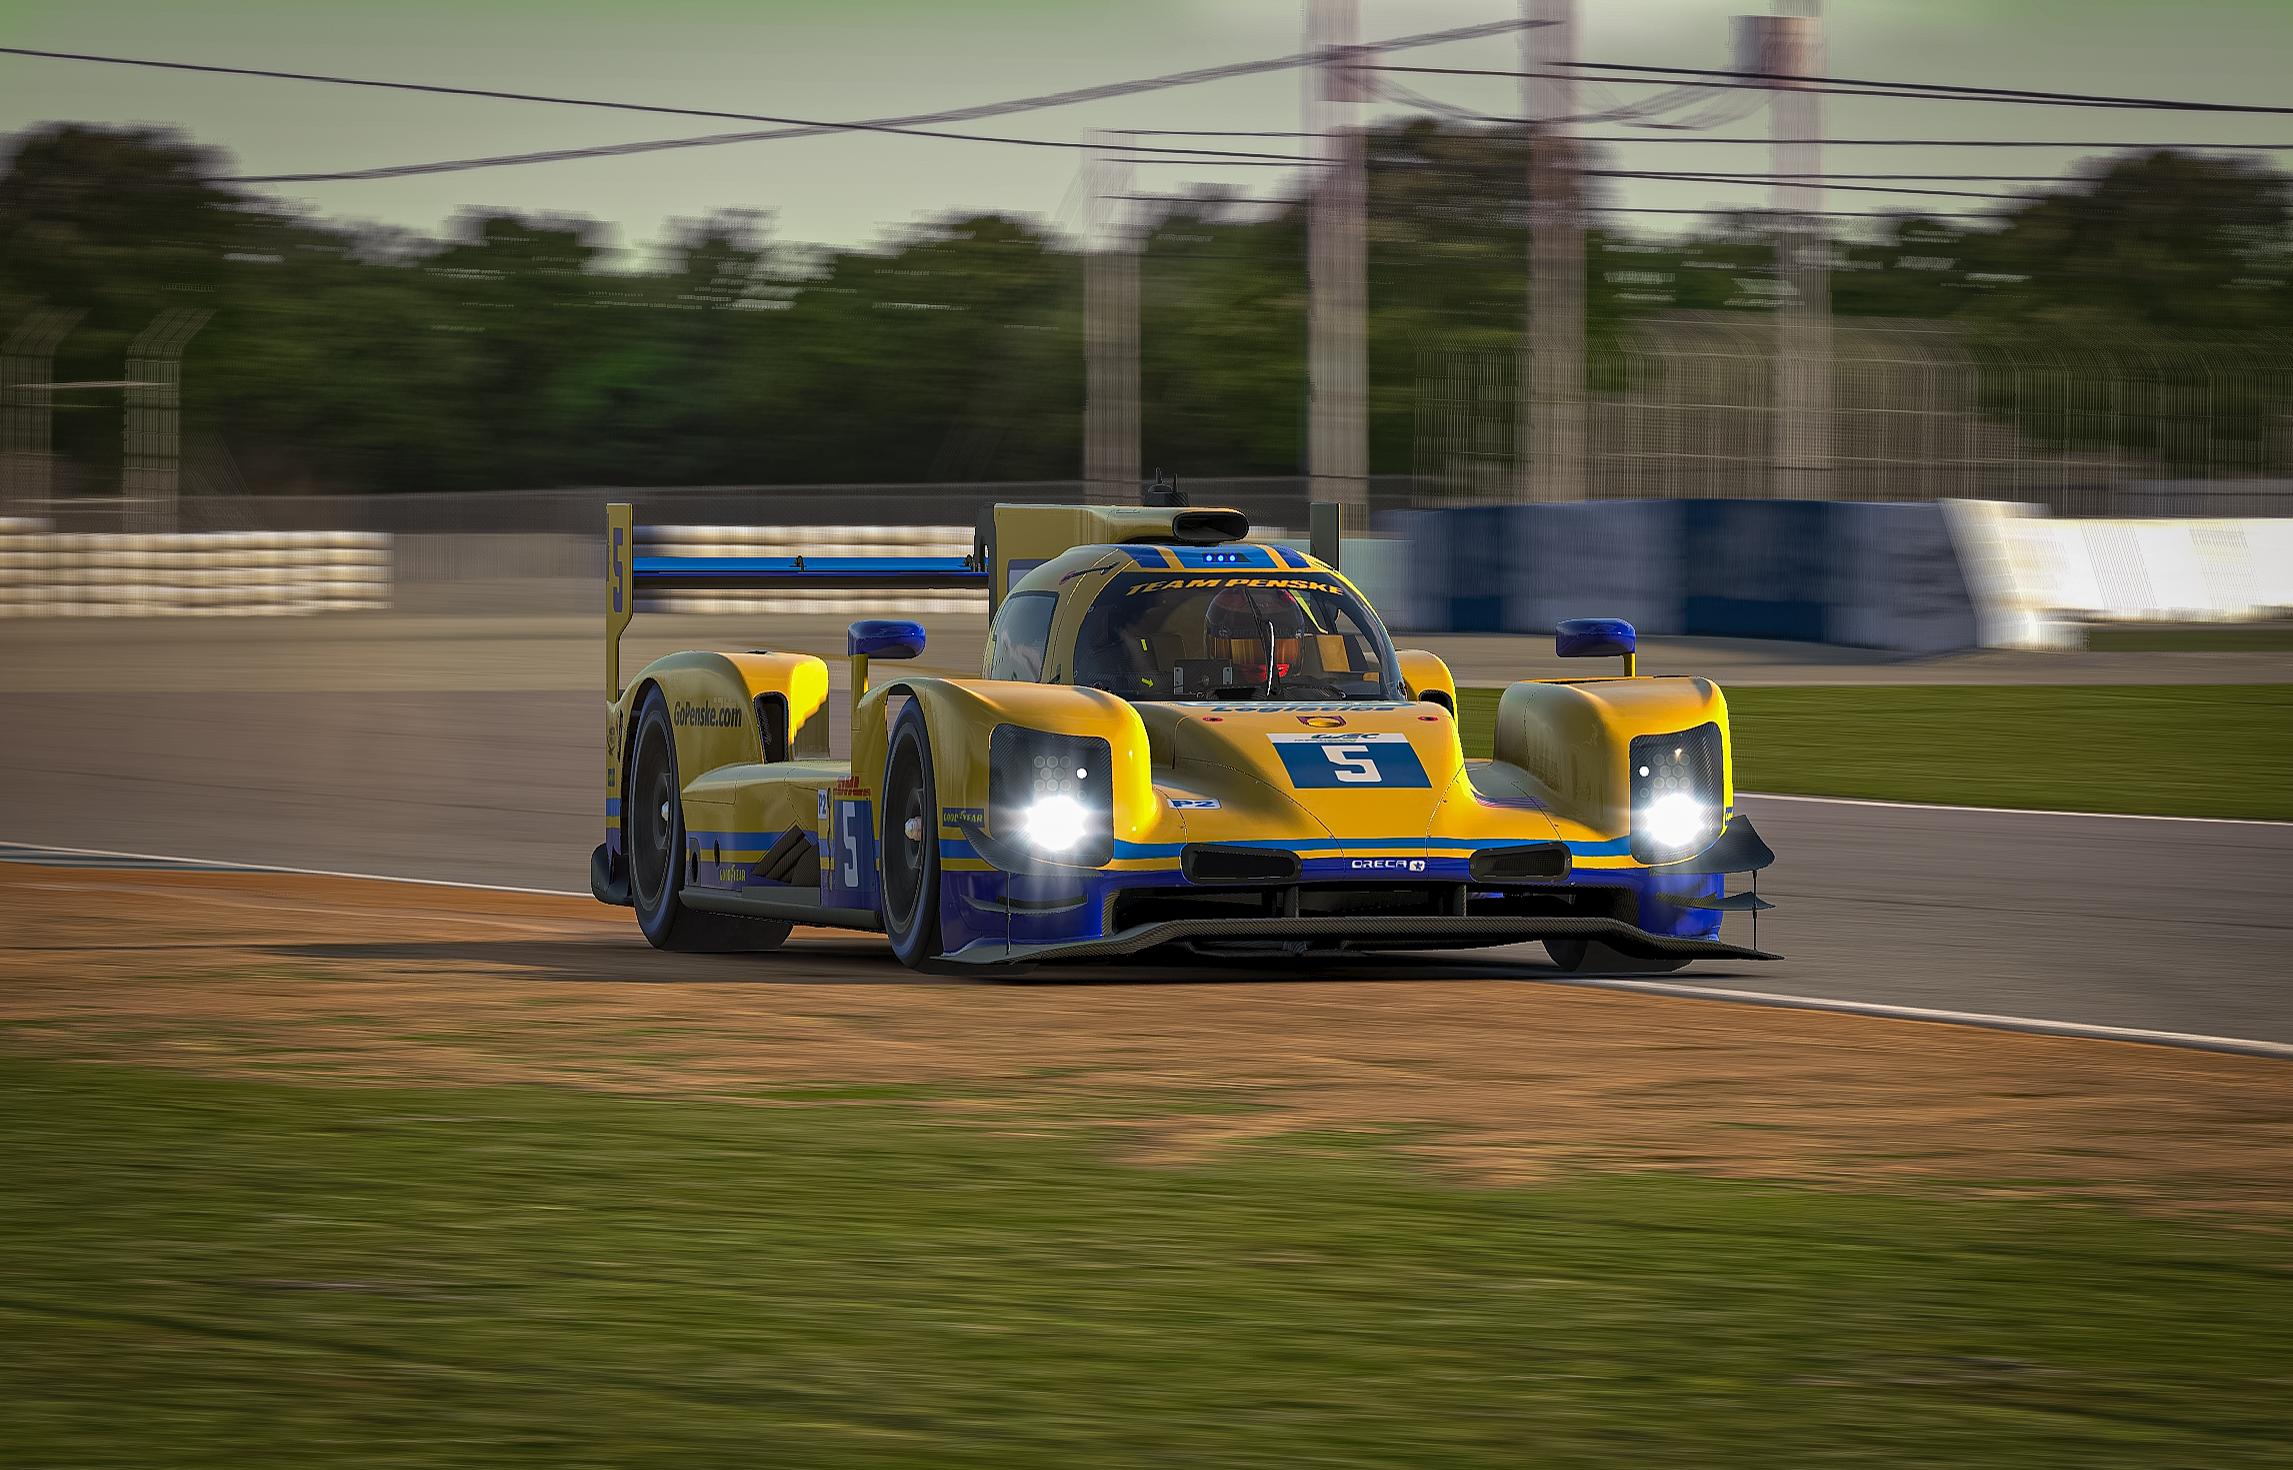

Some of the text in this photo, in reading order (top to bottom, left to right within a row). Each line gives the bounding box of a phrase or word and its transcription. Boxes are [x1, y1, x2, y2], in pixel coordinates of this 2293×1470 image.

[612, 527, 624, 613] 5
[1125, 578, 1344, 596] TEAM PENSKE
[674, 699, 742, 728] GoPenske.com
[1321, 745, 1382, 783] 5
[1172, 800, 1216, 808] P2
[842, 800, 859, 888] 5
[1351, 859, 1407, 869] ORECA
